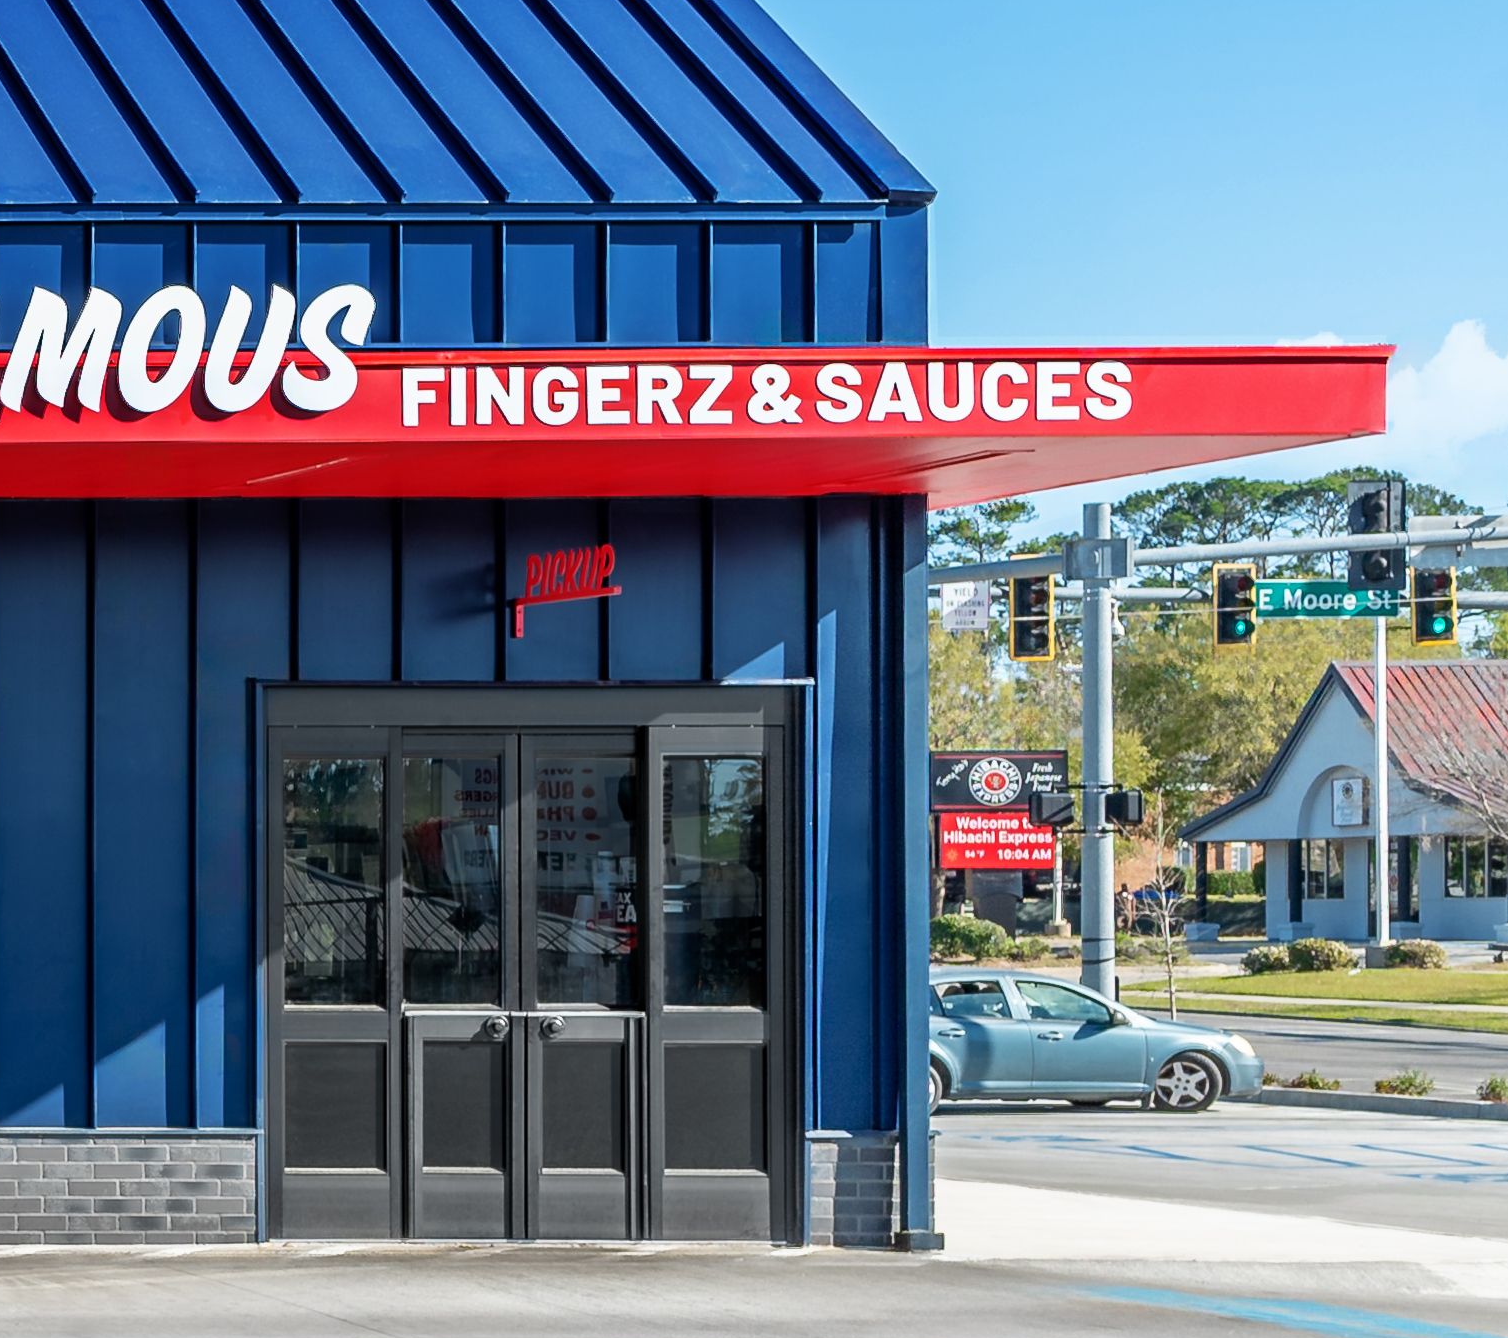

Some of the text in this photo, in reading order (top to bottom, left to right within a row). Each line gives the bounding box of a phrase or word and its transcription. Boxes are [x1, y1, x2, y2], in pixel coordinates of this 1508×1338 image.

[402, 360, 1133, 426] FINGERZ & SAUCES
[525, 544, 615, 598] PICKUP
[1259, 588, 1392, 611] E Moore St
[971, 759, 1019, 783] HIBACHI
[972, 783, 1019, 804] EXPRESS
[956, 816, 1020, 830] Welcome
[943, 830, 1053, 847] Hibachi Express
[997, 848, 1030, 860] 10:04
[1032, 848, 1052, 860] AM
